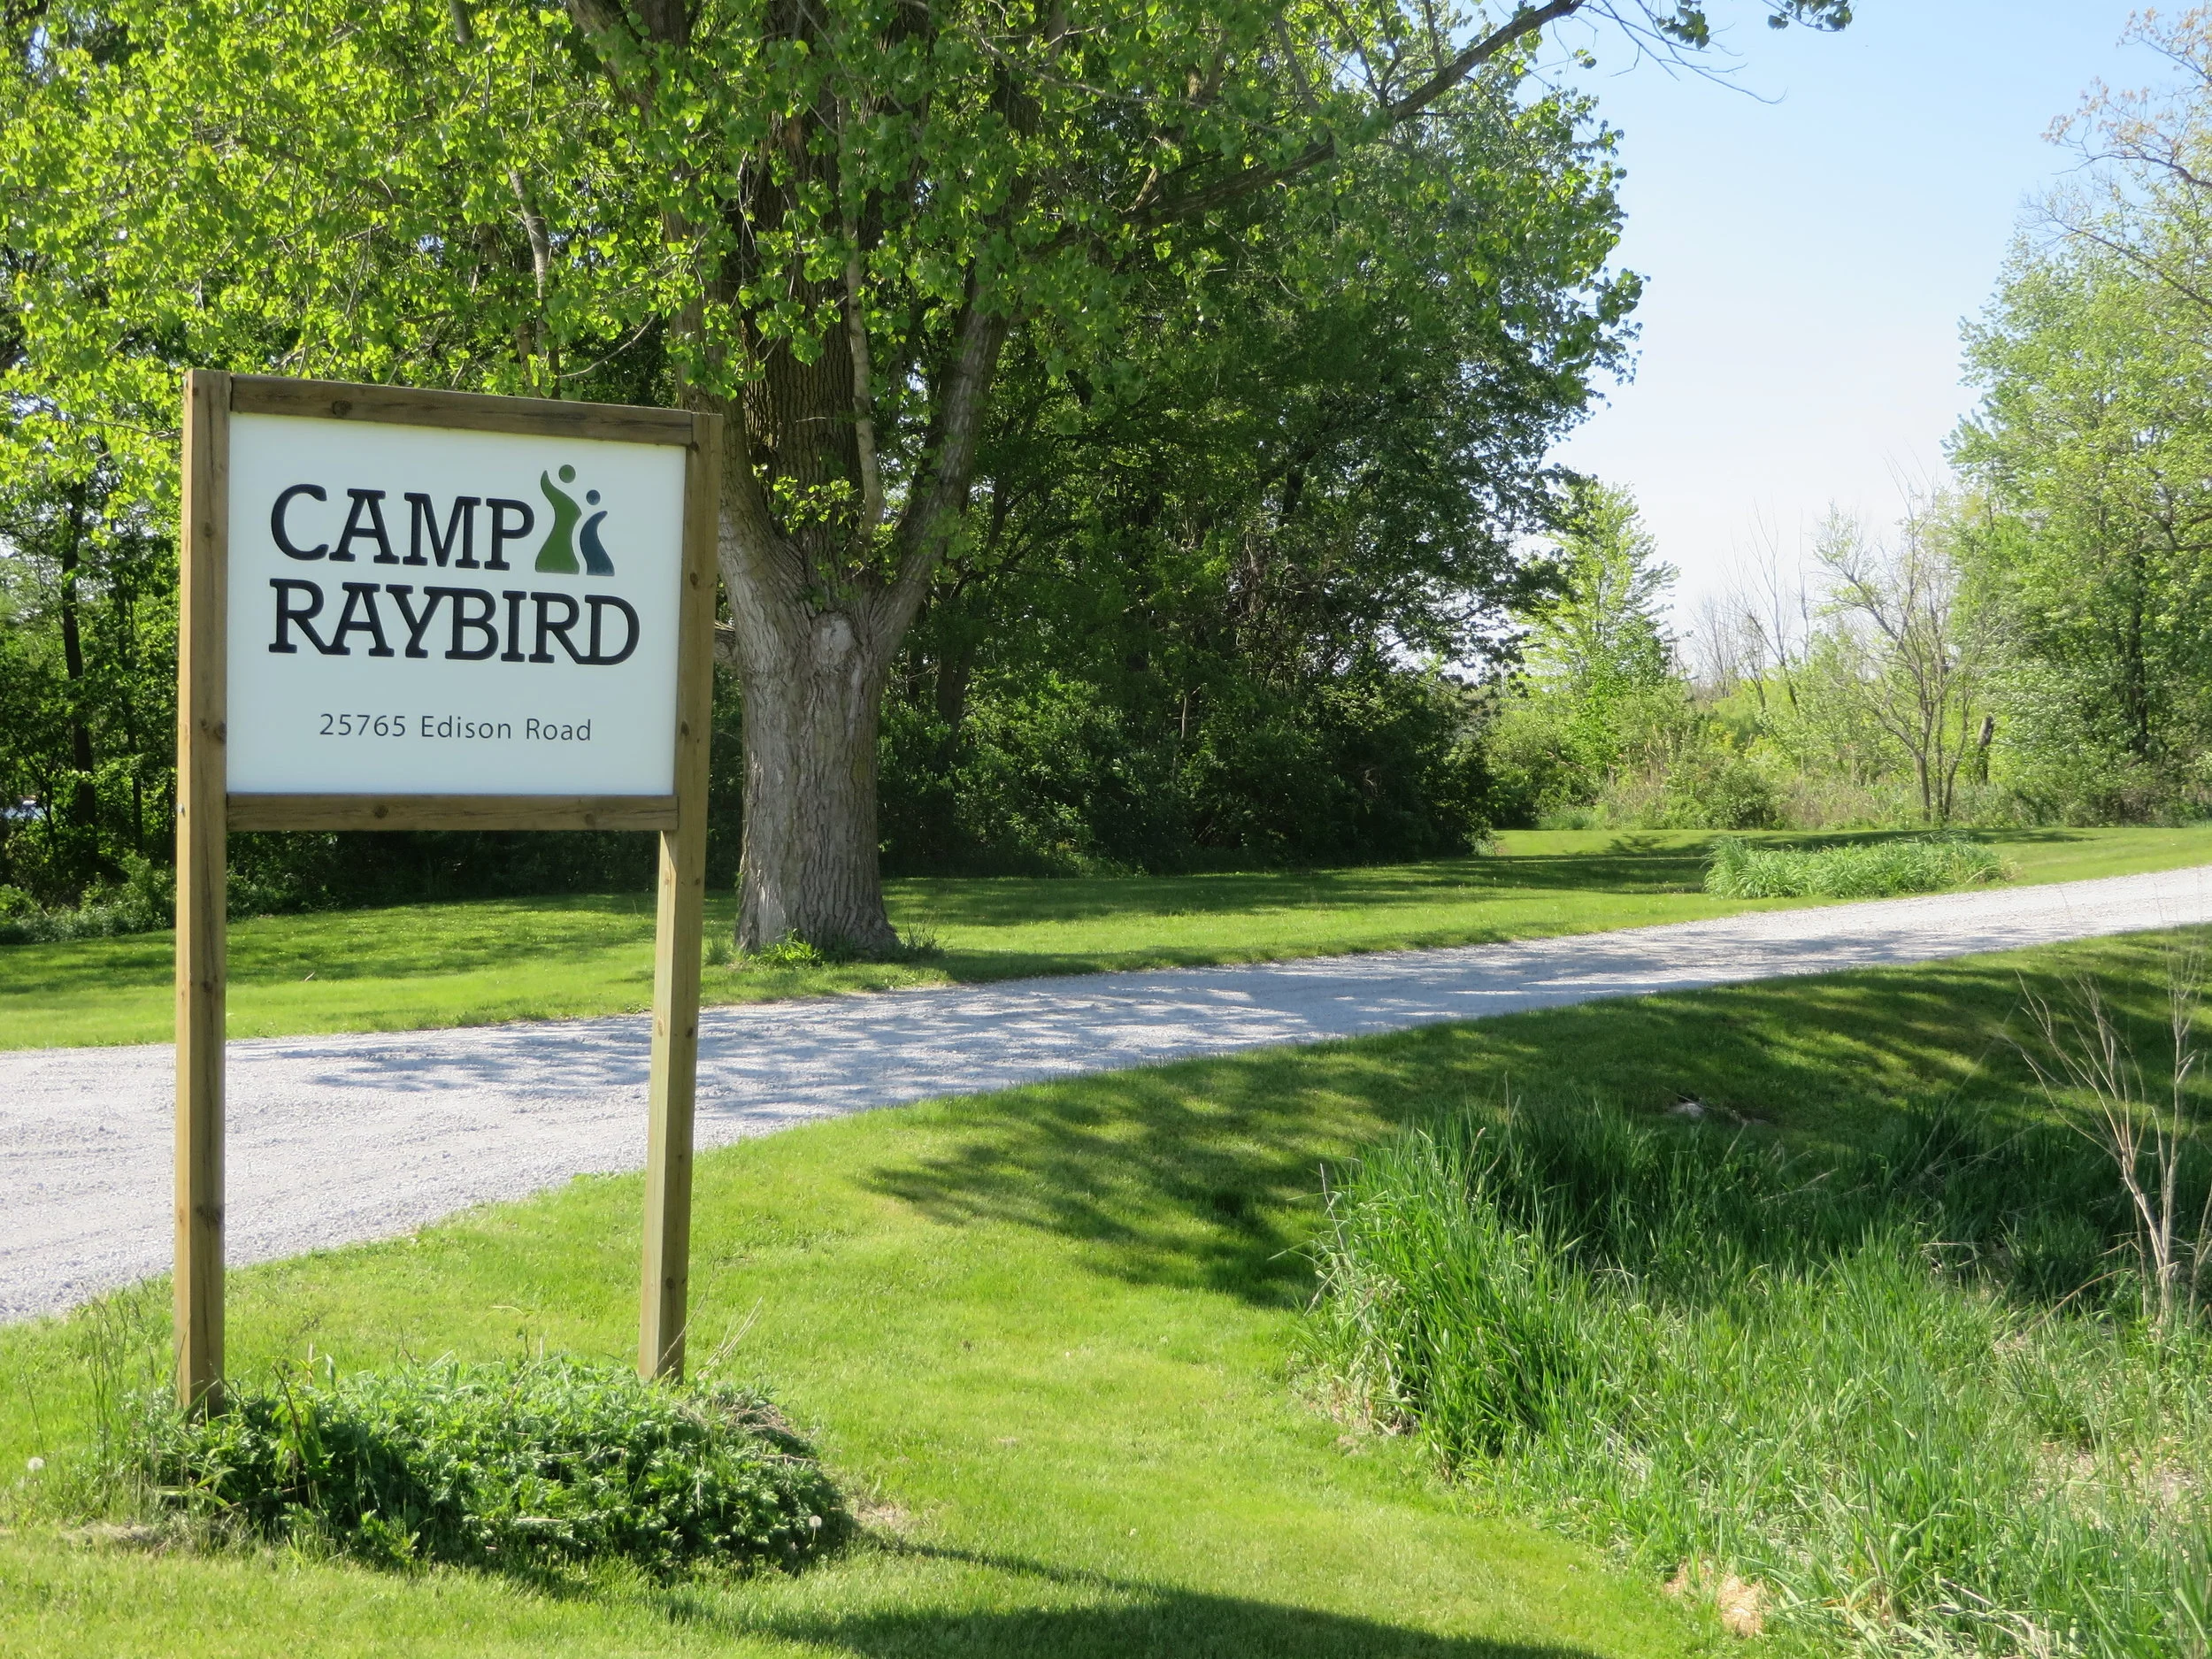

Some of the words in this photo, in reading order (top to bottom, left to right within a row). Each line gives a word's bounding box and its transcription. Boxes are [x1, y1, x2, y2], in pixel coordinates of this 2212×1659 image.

[270, 483, 535, 571] CAMP
[268, 577, 641, 665] RAYBIRD
[319, 713, 407, 737] 25765
[420, 715, 512, 740] Edison
[526, 718, 592, 741] Road
